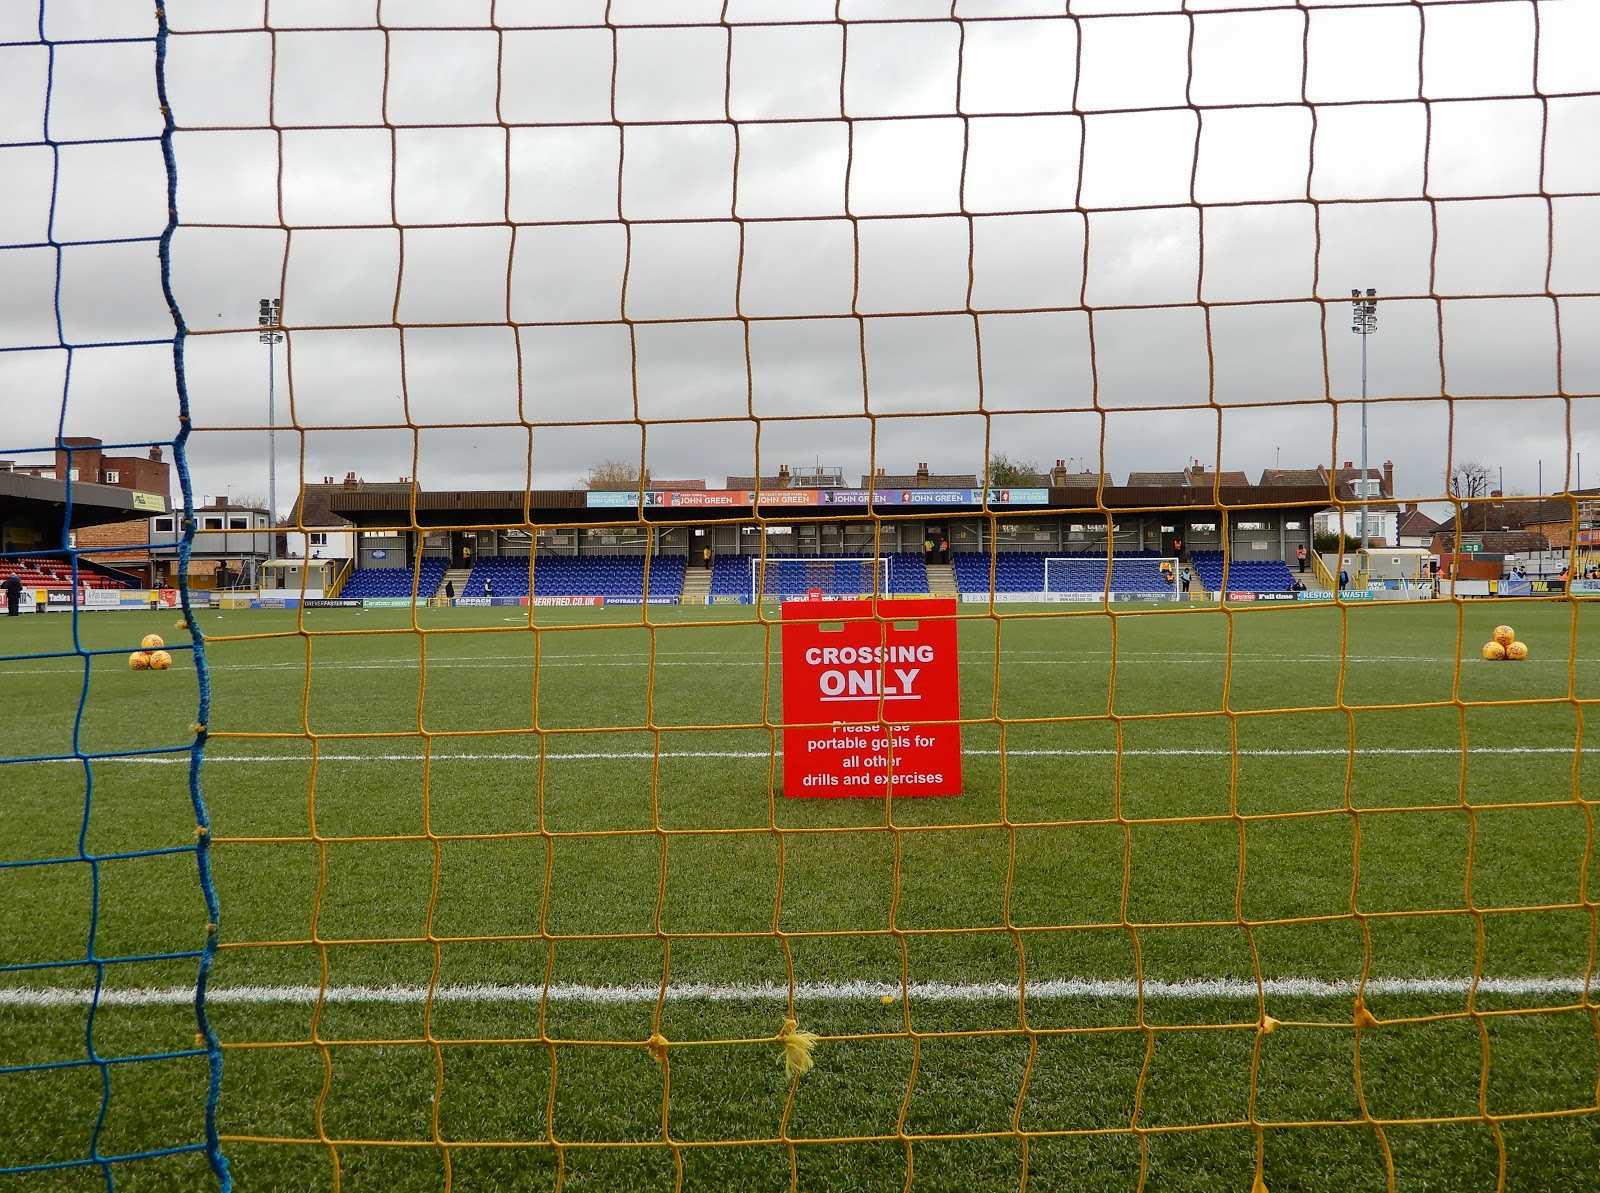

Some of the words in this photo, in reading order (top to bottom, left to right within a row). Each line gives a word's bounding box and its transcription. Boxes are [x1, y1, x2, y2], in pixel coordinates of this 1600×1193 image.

[527, 597, 595, 607] HERRYRED.CO.UK
[1303, 591, 1334, 599] RESTON
[1342, 591, 1369, 599] WASTE
[805, 645, 934, 665] CROSSING
[819, 668, 920, 696] ONLY
[808, 737, 867, 752] portable
[871, 735, 911, 751] goals
[915, 735, 935, 747] for
[842, 756, 860, 768] all
[802, 774, 839, 786] drills
[843, 773, 870, 785] and
[873, 772, 944, 784] exercises
